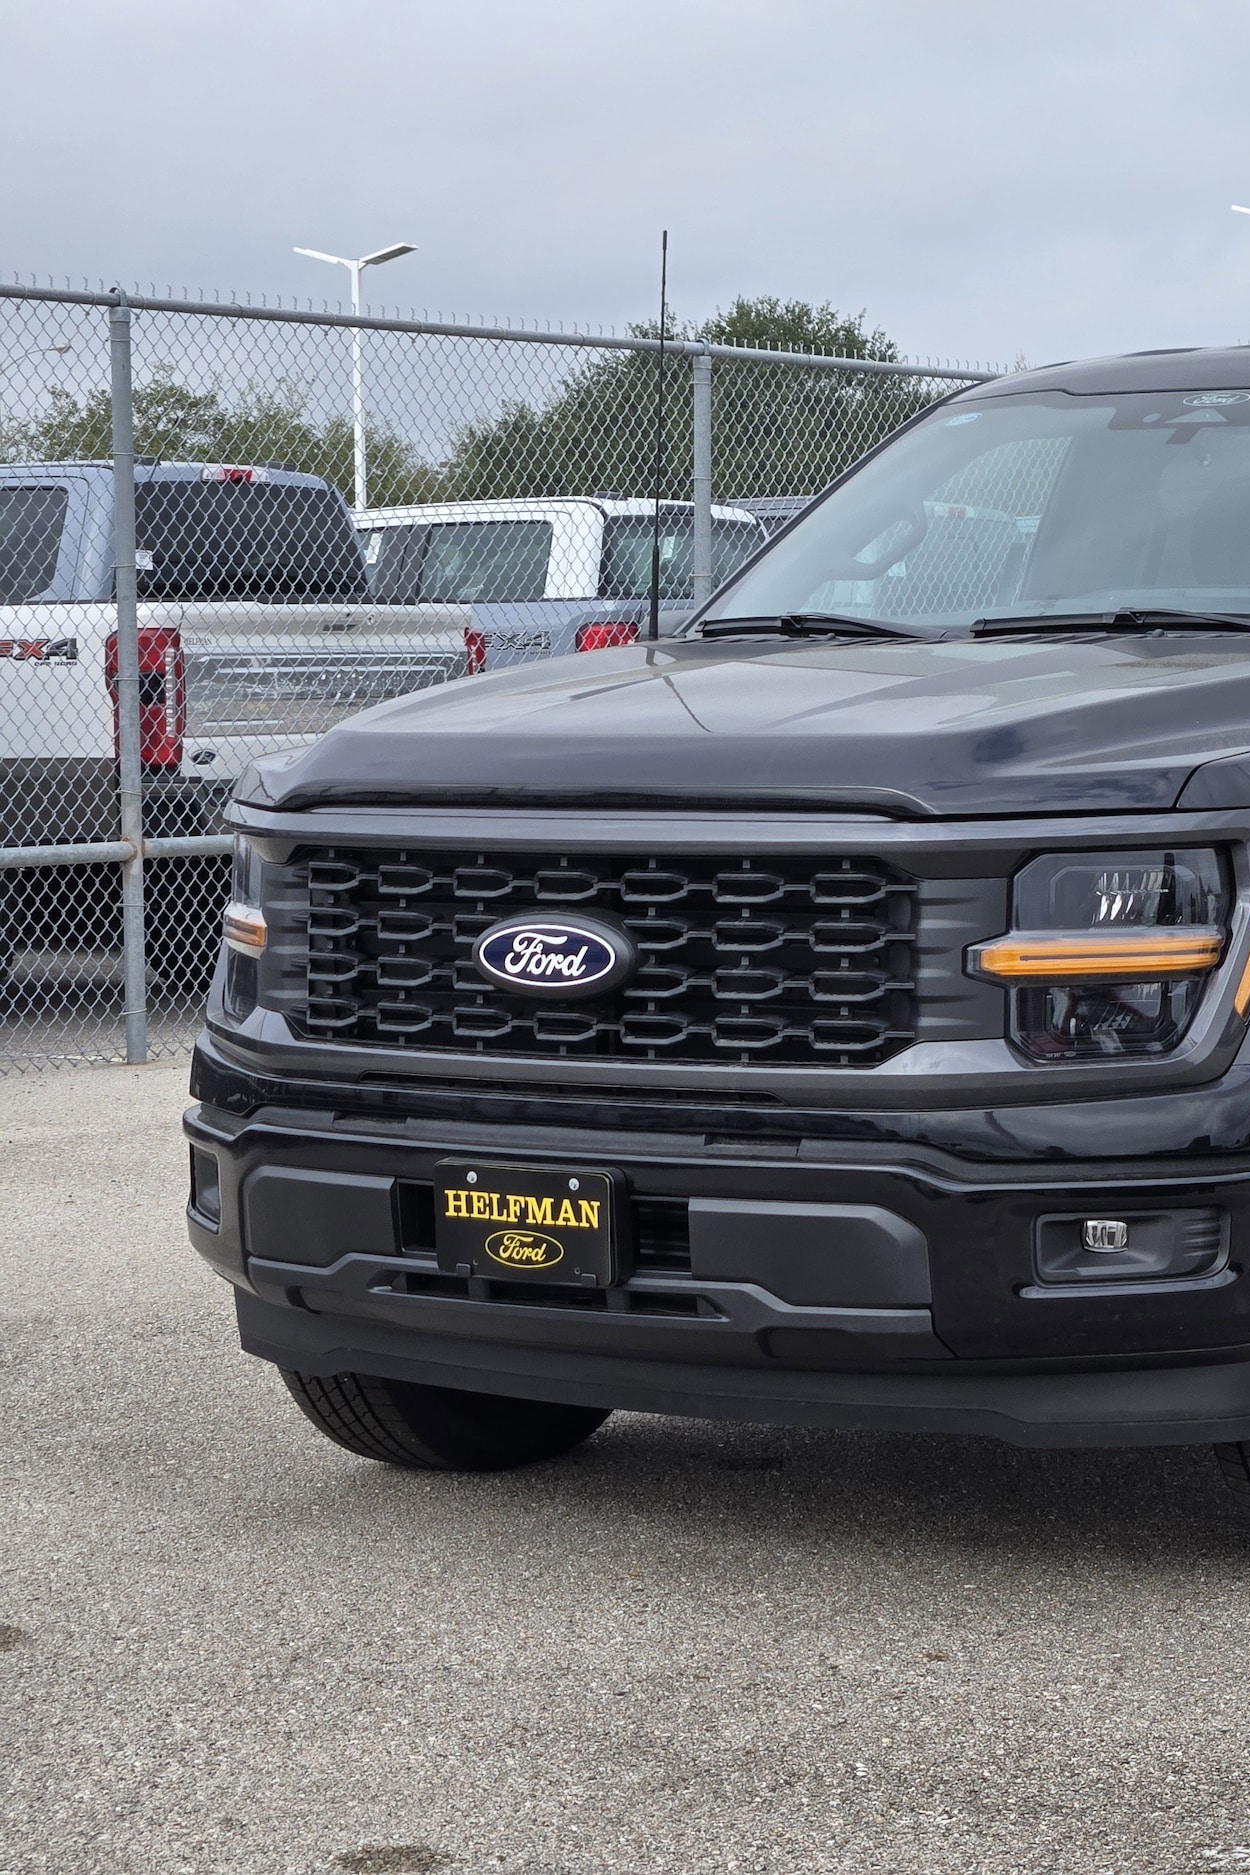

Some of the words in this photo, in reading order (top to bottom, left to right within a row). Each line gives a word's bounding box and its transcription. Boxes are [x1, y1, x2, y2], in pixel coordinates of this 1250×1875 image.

[504, 932, 589, 977] Ford
[443, 1189, 601, 1229] HELFMAN
[499, 1233, 547, 1262] Ford
